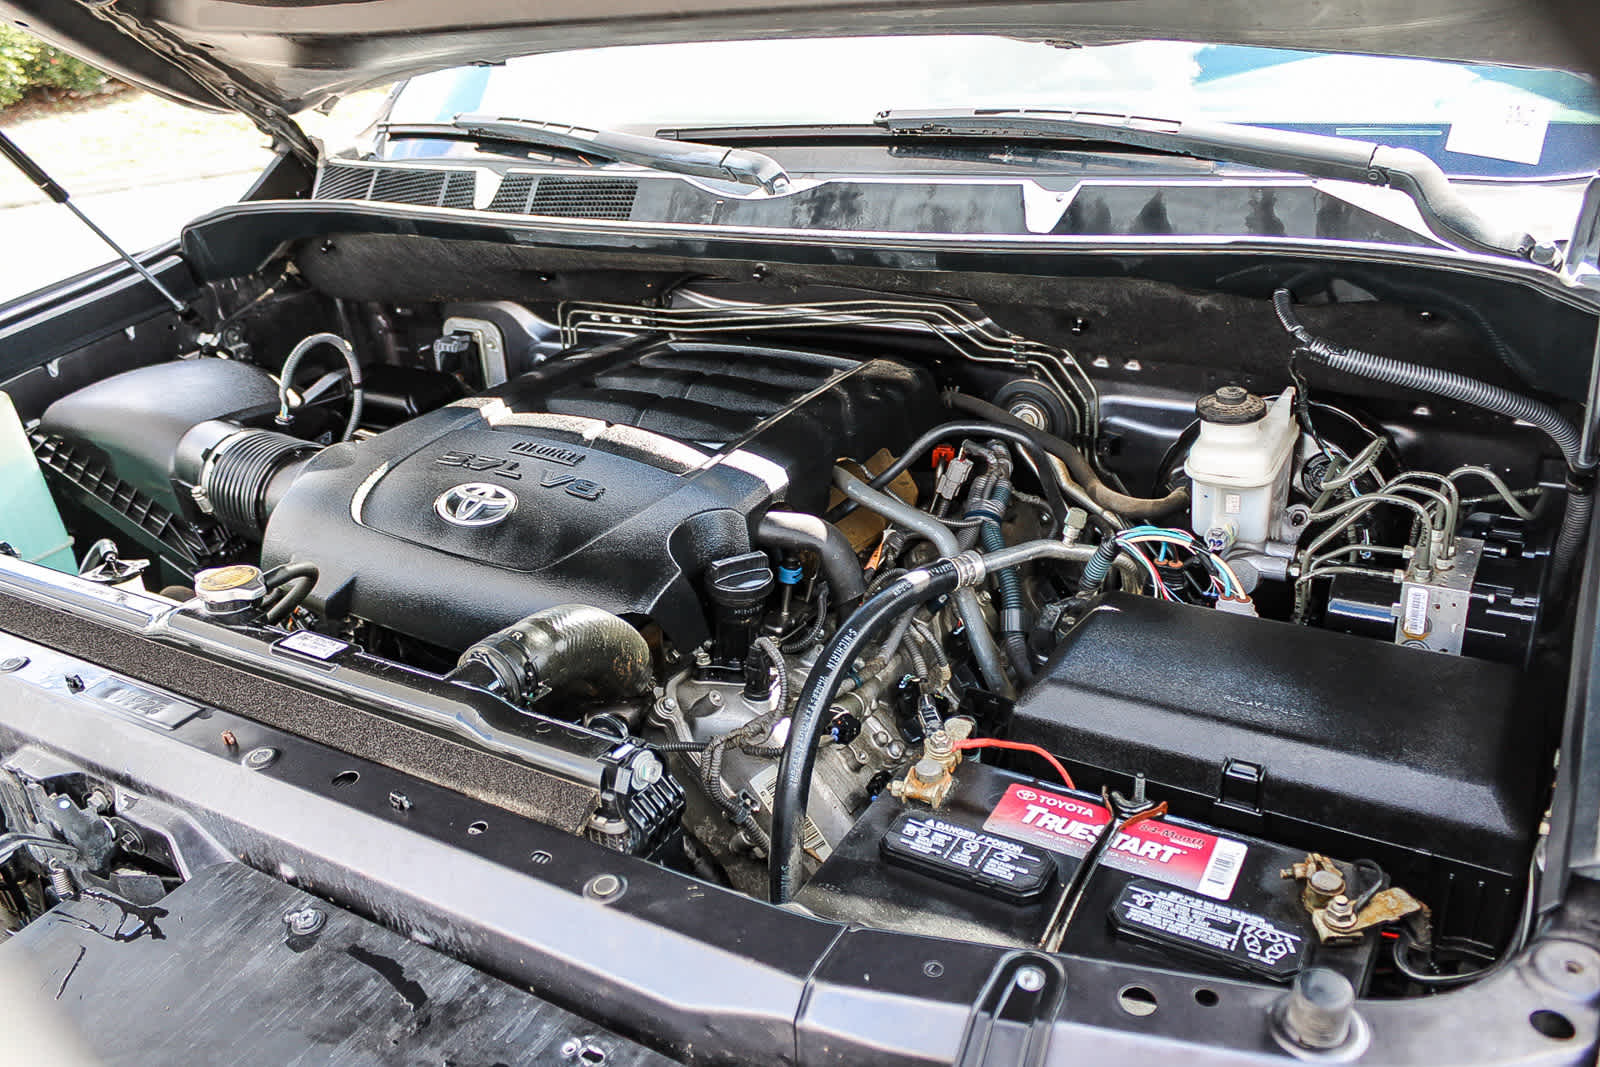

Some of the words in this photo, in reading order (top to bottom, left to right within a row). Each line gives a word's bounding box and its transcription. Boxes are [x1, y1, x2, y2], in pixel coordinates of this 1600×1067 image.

[435, 450, 522, 480] 5.7L
[539, 469, 602, 501] V8
[1039, 795, 1094, 818] TOYOTA
[935, 821, 977, 841] DANGER
[985, 837, 1024, 855] POISON
